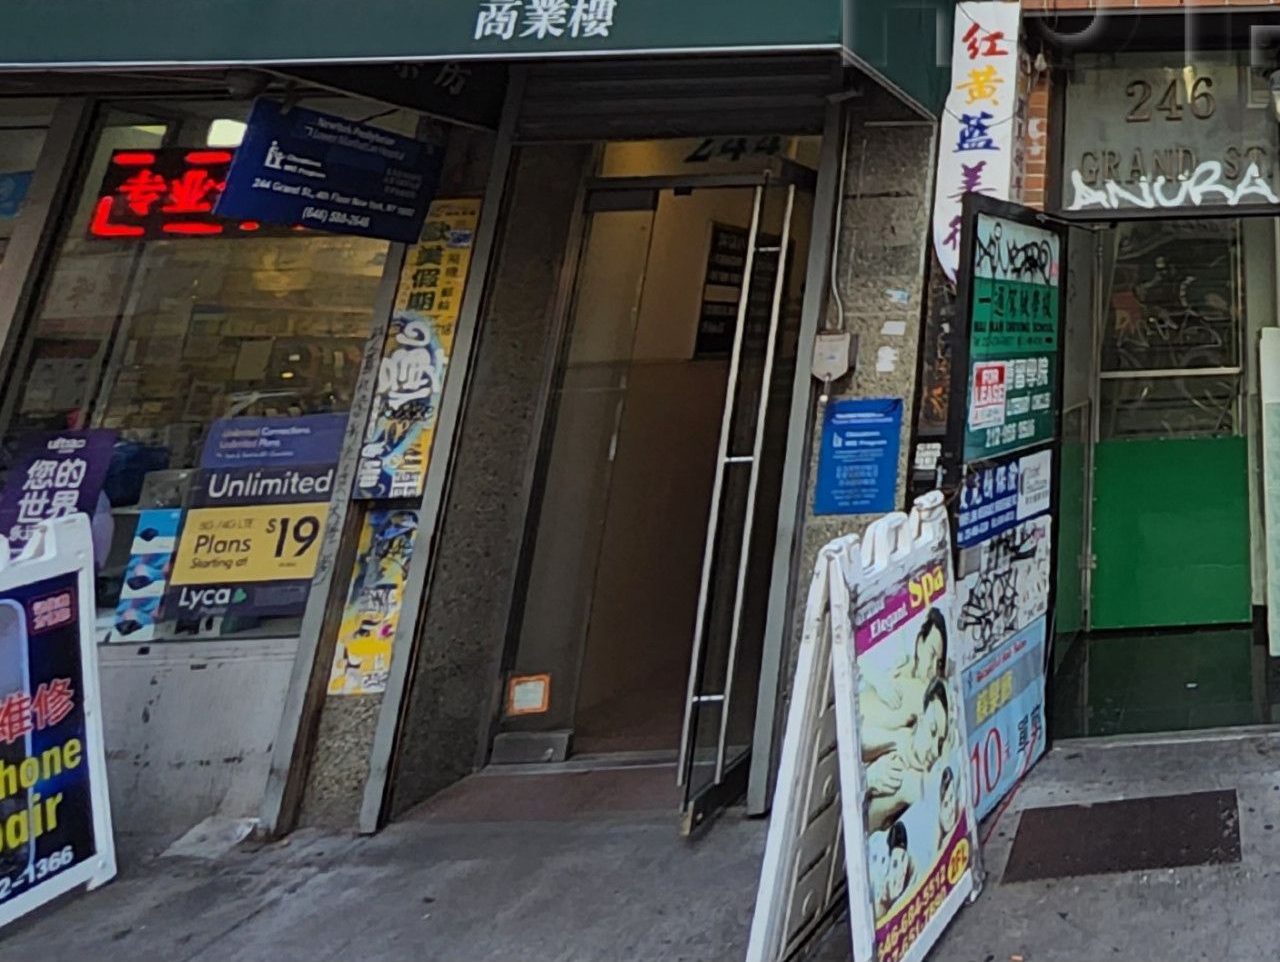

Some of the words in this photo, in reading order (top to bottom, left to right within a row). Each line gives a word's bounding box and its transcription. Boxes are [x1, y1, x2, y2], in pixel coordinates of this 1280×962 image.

[1125, 77, 1217, 123] 246
[1080, 144, 1198, 185] GRAND
[21, 458, 87, 490] 您的
[207, 469, 335, 499] Unlimited
[16, 489, 80, 524] 世界
[193, 534, 252, 555] Plans
[265, 515, 320, 559] $19
[189, 556, 232, 570] Starting
[178, 586, 232, 607] Lyca
[908, 565, 945, 608] Spa
[970, 726, 1002, 808] 10
